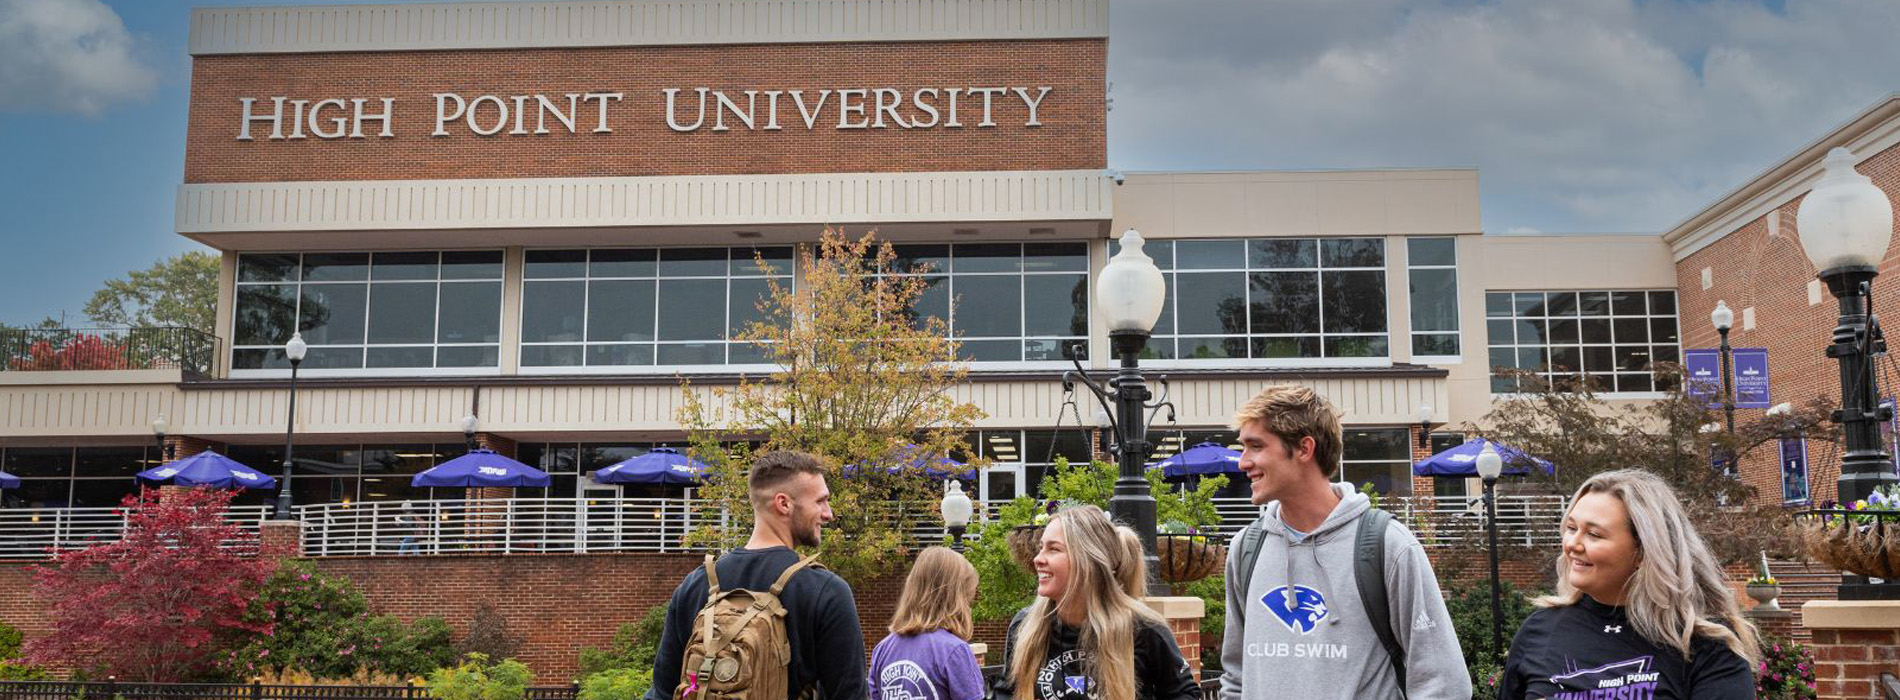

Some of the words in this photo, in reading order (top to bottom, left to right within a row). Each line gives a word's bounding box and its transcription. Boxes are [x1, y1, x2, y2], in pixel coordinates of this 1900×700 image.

[236, 96, 394, 140] HIGH
[431, 92, 623, 136] POINT
[663, 86, 1053, 131] UNIVERSITY
[1247, 643, 1289, 657] CLUB
[1294, 643, 1348, 659] SWIM
[1598, 676, 1624, 688] HIGH
[1627, 672, 1660, 684] POINT
